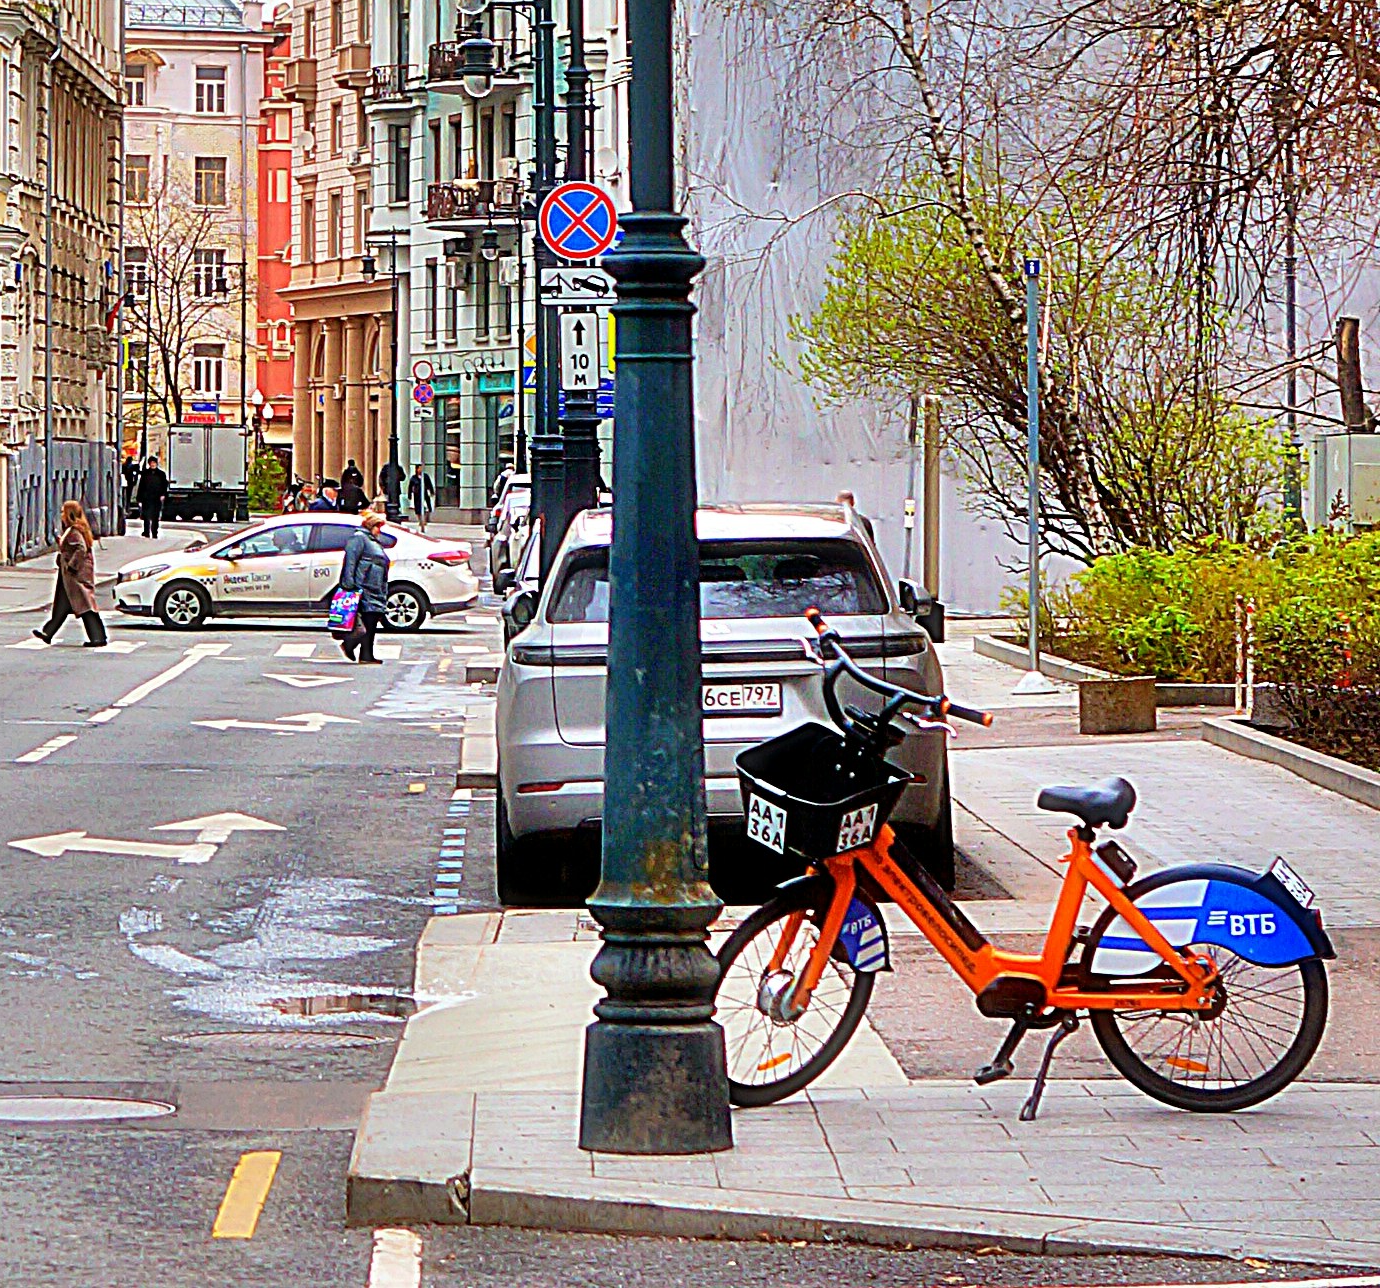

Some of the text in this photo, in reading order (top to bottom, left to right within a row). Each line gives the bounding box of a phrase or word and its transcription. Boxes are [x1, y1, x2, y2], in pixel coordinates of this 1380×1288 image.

[570, 353, 589, 370] 10
[313, 567, 331, 579] 890
[704, 685, 774, 707] 6СЕ 797
[851, 914, 872, 935] ВТБ
[1229, 913, 1277, 936] ВТБ
